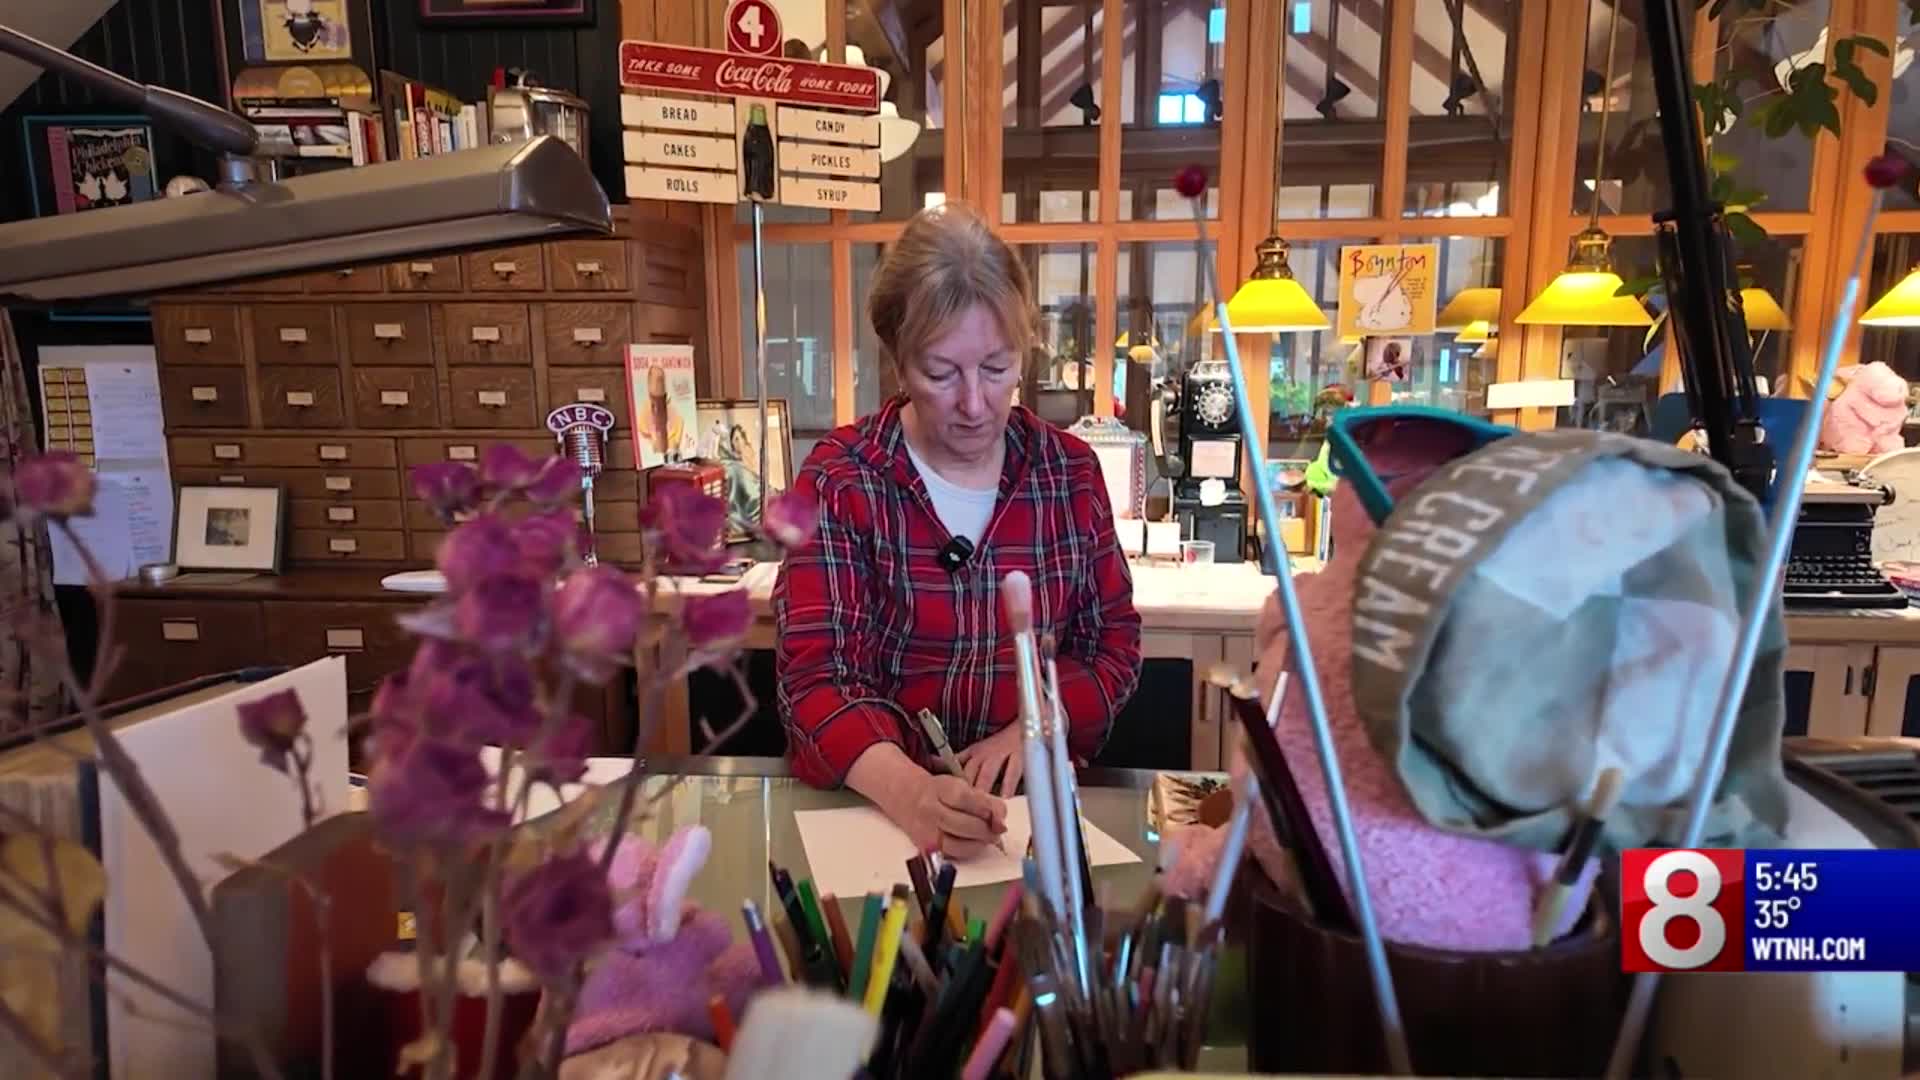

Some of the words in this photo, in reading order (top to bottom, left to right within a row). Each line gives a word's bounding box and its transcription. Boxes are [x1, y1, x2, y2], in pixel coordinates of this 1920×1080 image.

[737, 5, 765, 48] 4
[628, 59, 663, 72] TAKE
[666, 62, 702, 77] SOME
[799, 77, 833, 90] HOME
[836, 80, 875, 94] TODAY
[662, 106, 698, 121] BREAD
[815, 119, 846, 133] CANDY
[663, 143, 697, 158] CAKES
[811, 153, 851, 169] PICKLES
[666, 178, 699, 193] ROLLS
[817, 188, 848, 202] SYRUP
[1349, 248, 1426, 279] Boynton
[555, 406, 607, 427] NBC
[1353, 490, 1505, 673] CREAM
